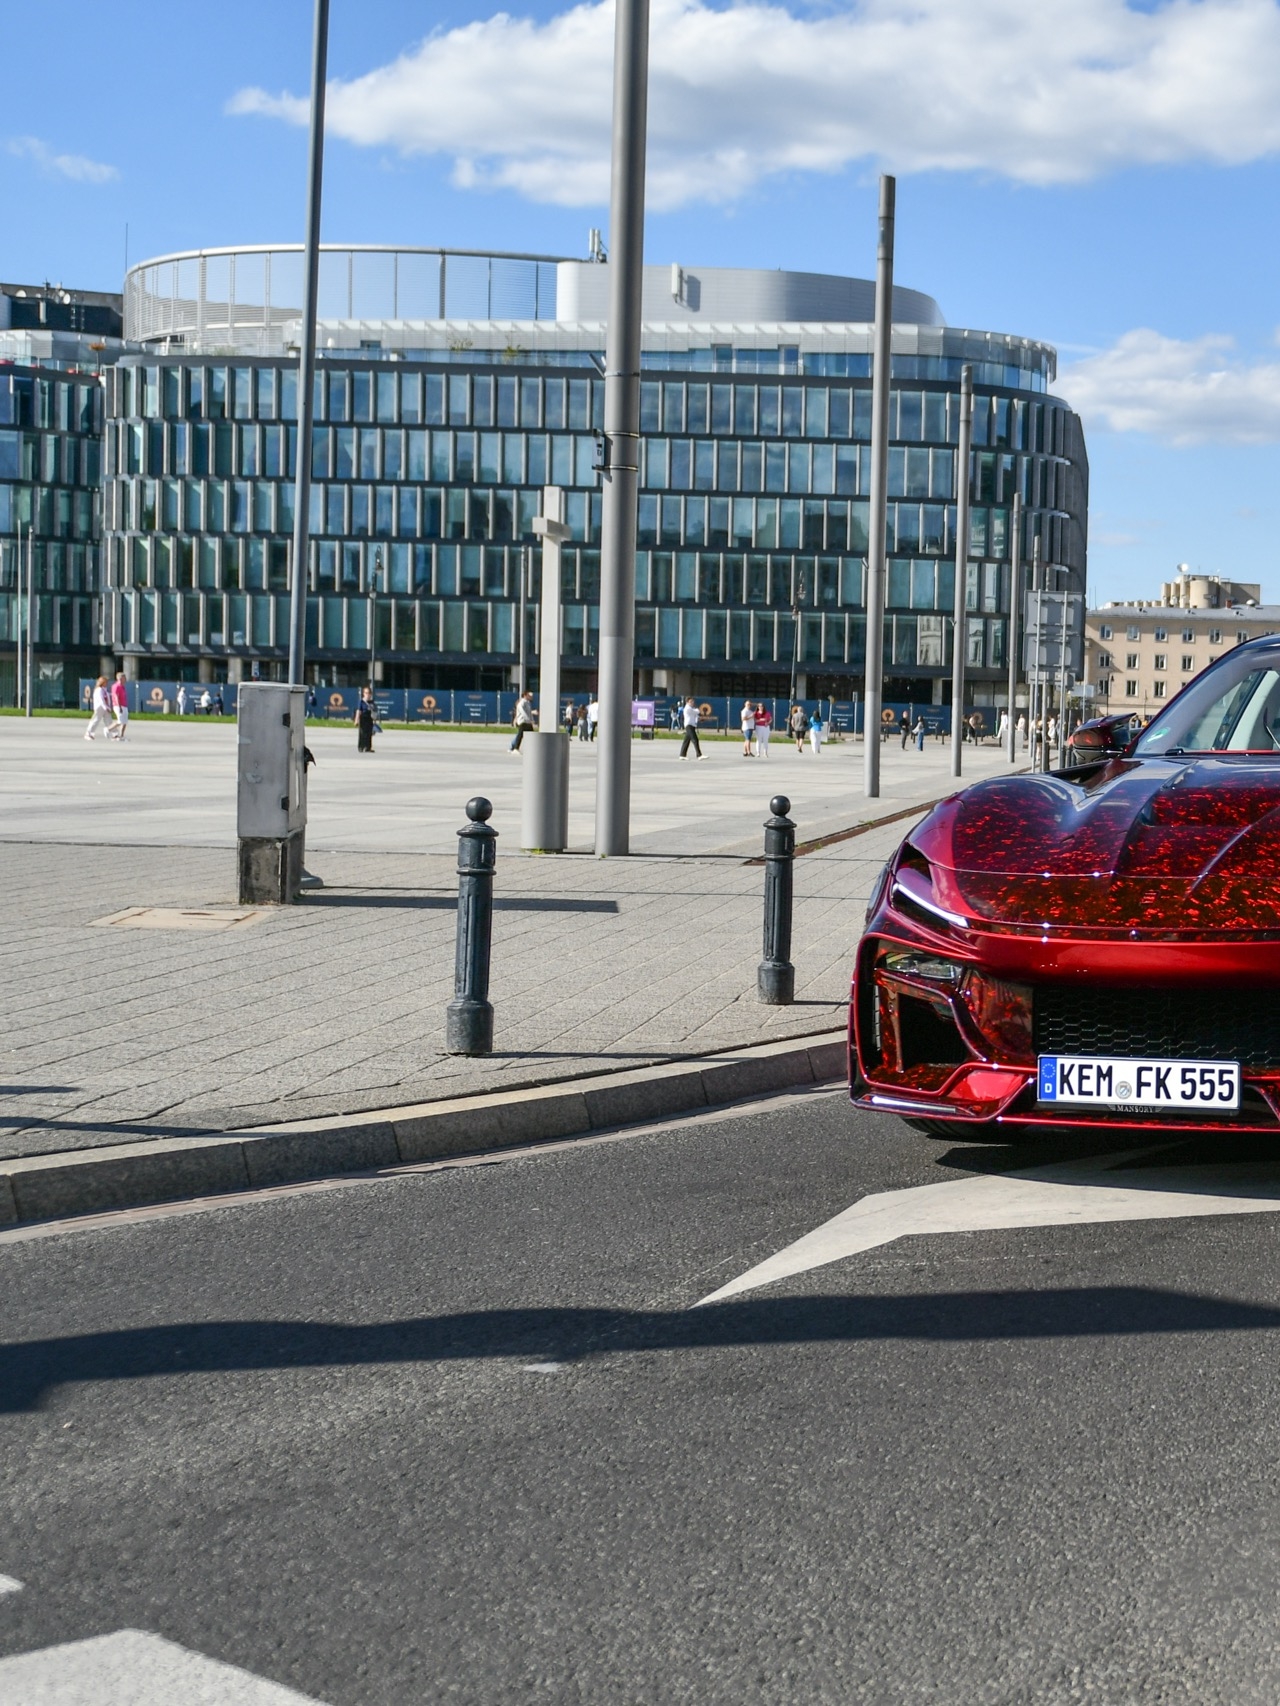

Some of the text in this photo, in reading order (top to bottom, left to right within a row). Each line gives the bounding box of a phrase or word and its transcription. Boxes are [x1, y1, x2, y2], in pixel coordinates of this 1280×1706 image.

[1044, 1082, 1053, 1093] D
[1059, 1063, 1234, 1102] KEM FK 555
[1116, 1104, 1154, 1113] MANSORY
